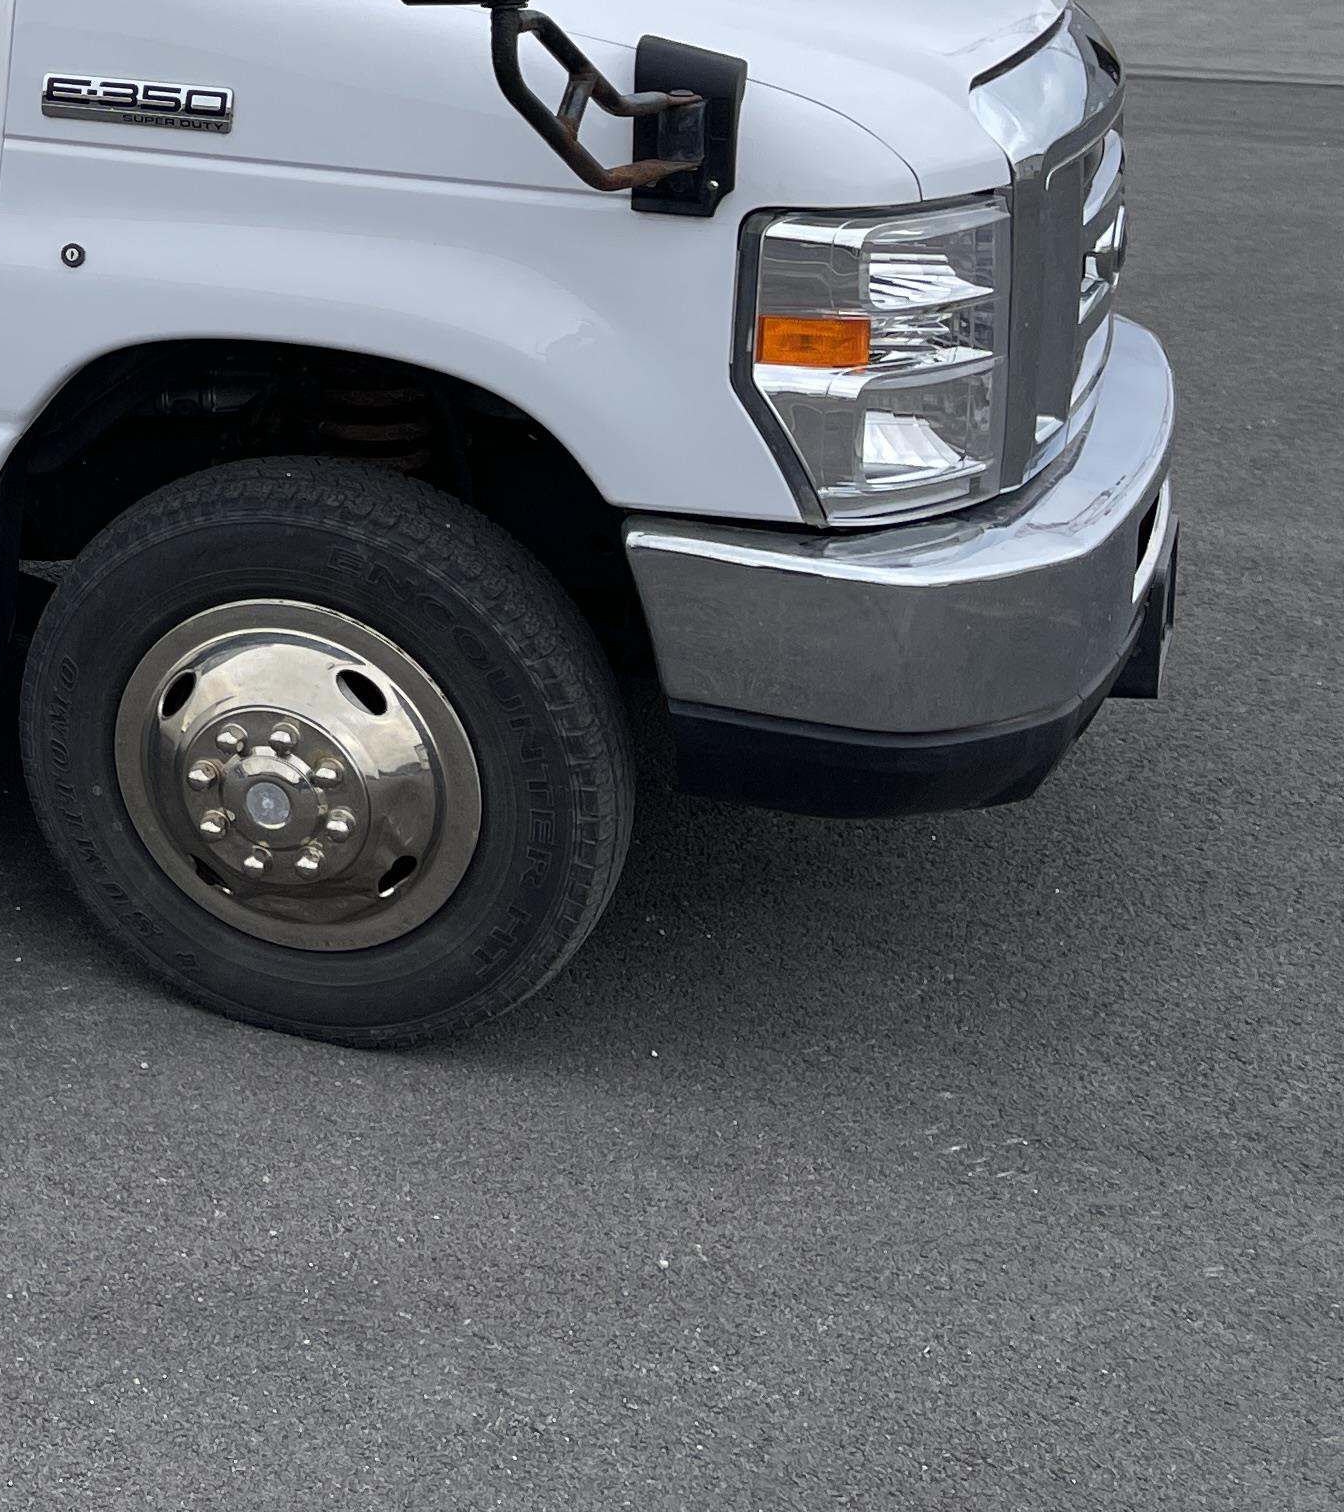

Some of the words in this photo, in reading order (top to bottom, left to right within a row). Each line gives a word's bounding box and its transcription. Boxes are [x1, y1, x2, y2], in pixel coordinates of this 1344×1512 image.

[46, 77, 228, 117] E-350
[122, 114, 175, 127] SUPER
[180, 119, 224, 131] DUTY
[325, 543, 556, 888] ENCOUNTER
[46, 655, 165, 938] SUMITOMO
